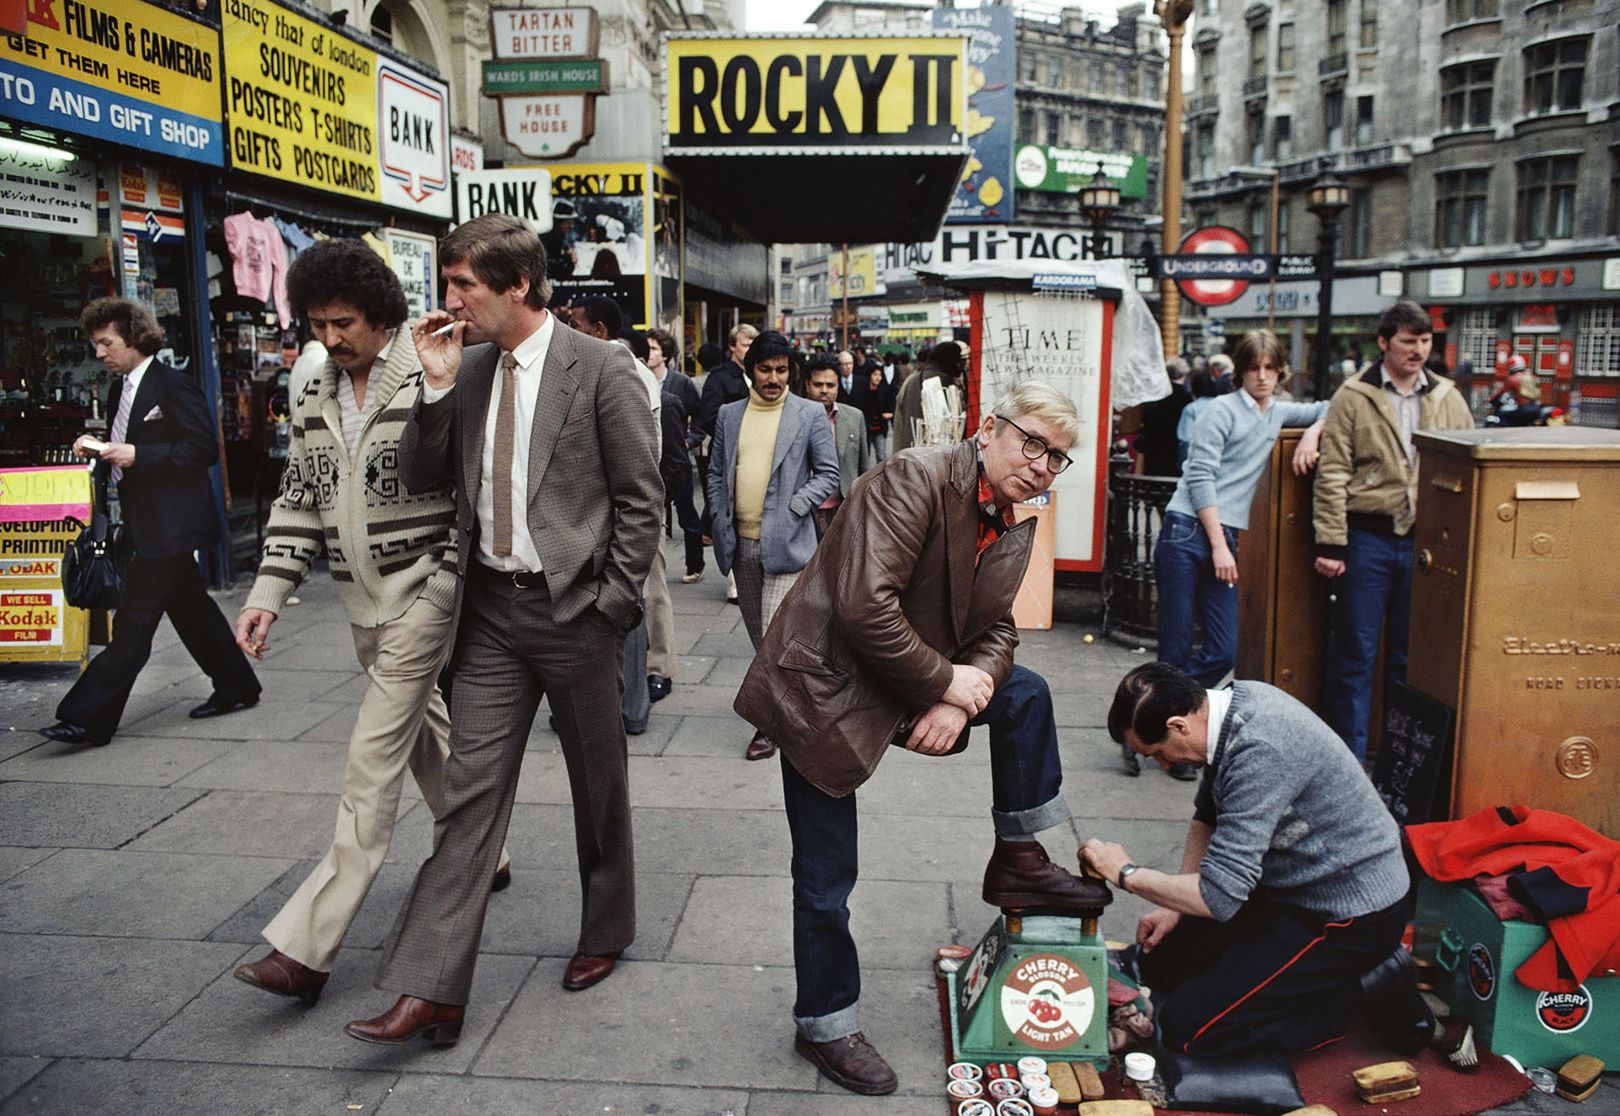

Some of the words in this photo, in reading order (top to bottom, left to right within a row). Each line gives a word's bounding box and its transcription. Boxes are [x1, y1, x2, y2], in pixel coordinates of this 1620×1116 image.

[508, 13, 574, 31] TARTAN
[64, 0, 119, 51] FILMS
[125, 22, 135, 57] &
[140, 28, 213, 82] CAMERAS
[275, 15, 303, 46] that
[330, 40, 370, 76] london
[512, 35, 572, 53] BITTER
[7, 35, 49, 60] GET
[56, 48, 109, 79] THEM
[117, 68, 161, 95] HERE
[260, 42, 345, 106] SOUVENIRS
[487, 70, 526, 83] WARDS
[529, 69, 559, 82] IRISH
[562, 68, 599, 81] HOUSE
[679, 54, 898, 134] ROCKY
[908, 54, 958, 134] II
[49, 87, 100, 122] AND
[110, 104, 153, 136] GIFT
[160, 118, 210, 150] SHOP
[231, 77, 303, 133] POSTERS
[311, 108, 372, 155] T-SHIRTS
[525, 104, 561, 116] FREE
[390, 105, 434, 155] BANK
[519, 120, 569, 133] HOUSE
[234, 127, 282, 171] GIFTS
[294, 145, 375, 194] POSTCARDS
[552, 174, 610, 196] CKY
[468, 181, 539, 221] BANK
[1163, 258, 1267, 275] UNDERGROUND
[1488, 267, 1575, 288] SNOWS
[1001, 328, 1081, 351] TIME
[998, 353, 1023, 363] THE
[1031, 354, 1084, 364] WEEKLY
[0, 520, 76, 533] VELOPING
[0, 562, 56, 574] ODAK
[7, 595, 22, 605] WE
[23, 595, 47, 605] SELL
[0, 610, 57, 625] Kodak
[14, 631, 37, 640] FILM
[1016, 958, 1080, 980] CHERRY
[1028, 970, 1067, 983] BLOSSOM
[1542, 993, 1588, 1007] CHERRY
[1021, 1025, 1051, 1042] LIGHT
[1052, 1026, 1075, 1041] TAN
